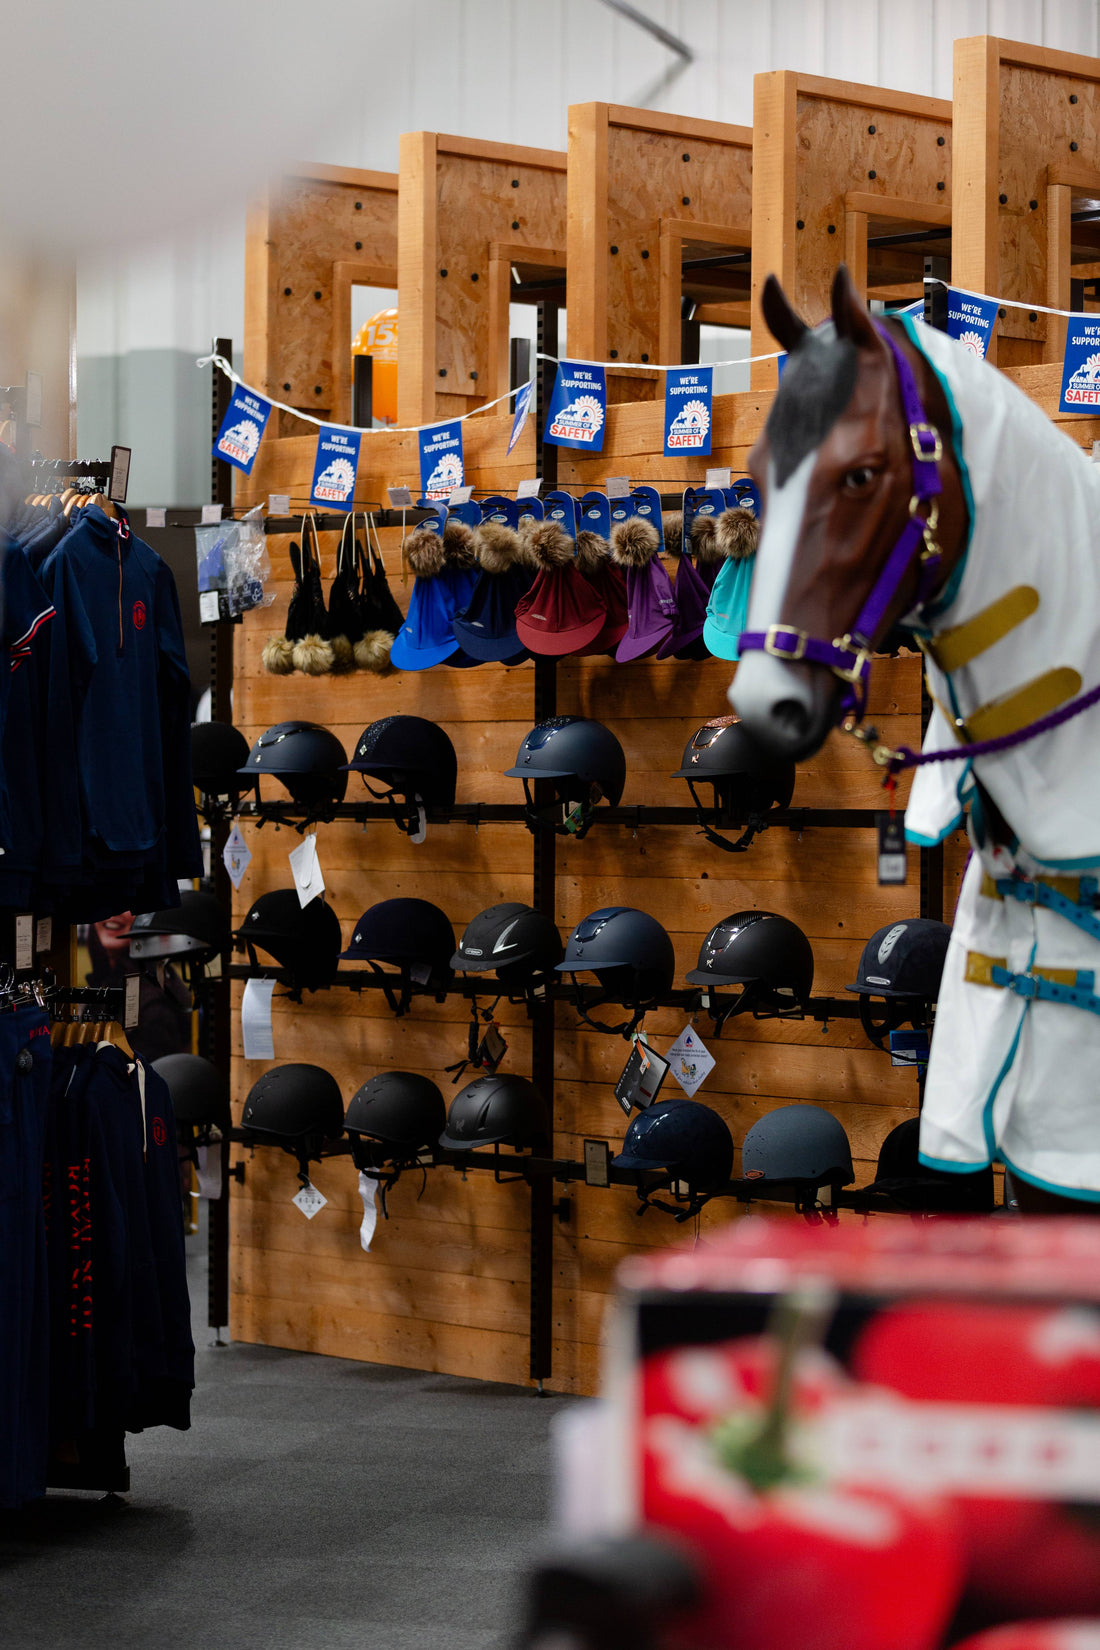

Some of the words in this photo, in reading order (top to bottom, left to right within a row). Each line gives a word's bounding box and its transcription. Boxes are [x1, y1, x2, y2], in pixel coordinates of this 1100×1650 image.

[961, 303, 982, 316] WE'RE
[947, 310, 990, 329] SUPPORTING
[367, 323, 398, 346] 15
[1084, 326, 1100, 335] WE'R
[1071, 336, 1100, 346] SUPPOR
[574, 371, 592, 380] WE'RE
[680, 376, 699, 385] WE'RE
[561, 379, 602, 391] SUPPORTING
[670, 385, 708, 395] SUPPORTING
[1066, 390, 1100, 403] SAFET
[551, 424, 595, 440] SAFETY
[423, 438, 460, 453] SUPPORTING
[669, 434, 704, 447] SAFETY
[219, 440, 250, 463] SAFETY
[321, 442, 356, 455] SUPPORTING
[315, 486, 347, 501] SAFETY
